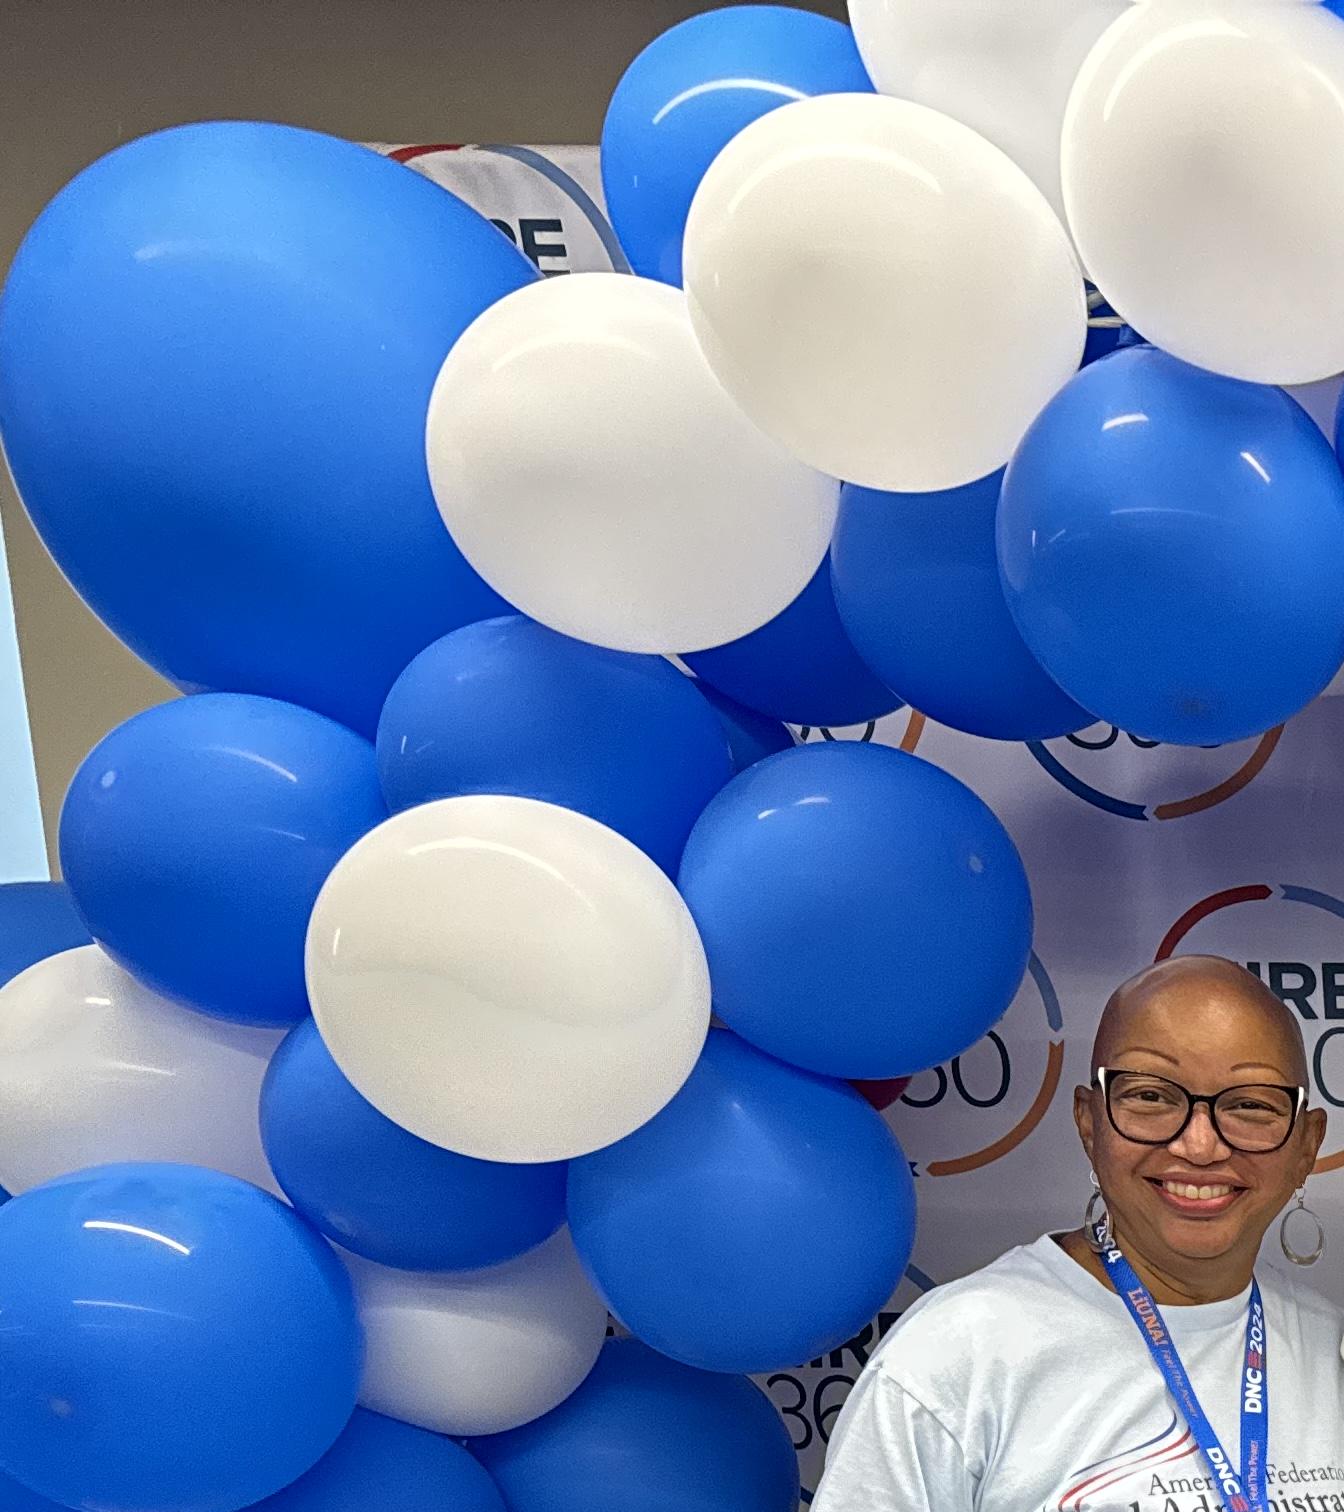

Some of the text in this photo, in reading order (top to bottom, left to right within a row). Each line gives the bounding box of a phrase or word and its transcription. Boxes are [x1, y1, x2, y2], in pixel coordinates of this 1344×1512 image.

[1244, 1302, 1263, 1414] DNC 2024
[766, 1373, 857, 1450] 36
[1148, 1473, 1214, 1496] Amer
[1206, 1447, 1240, 1496] DNC
